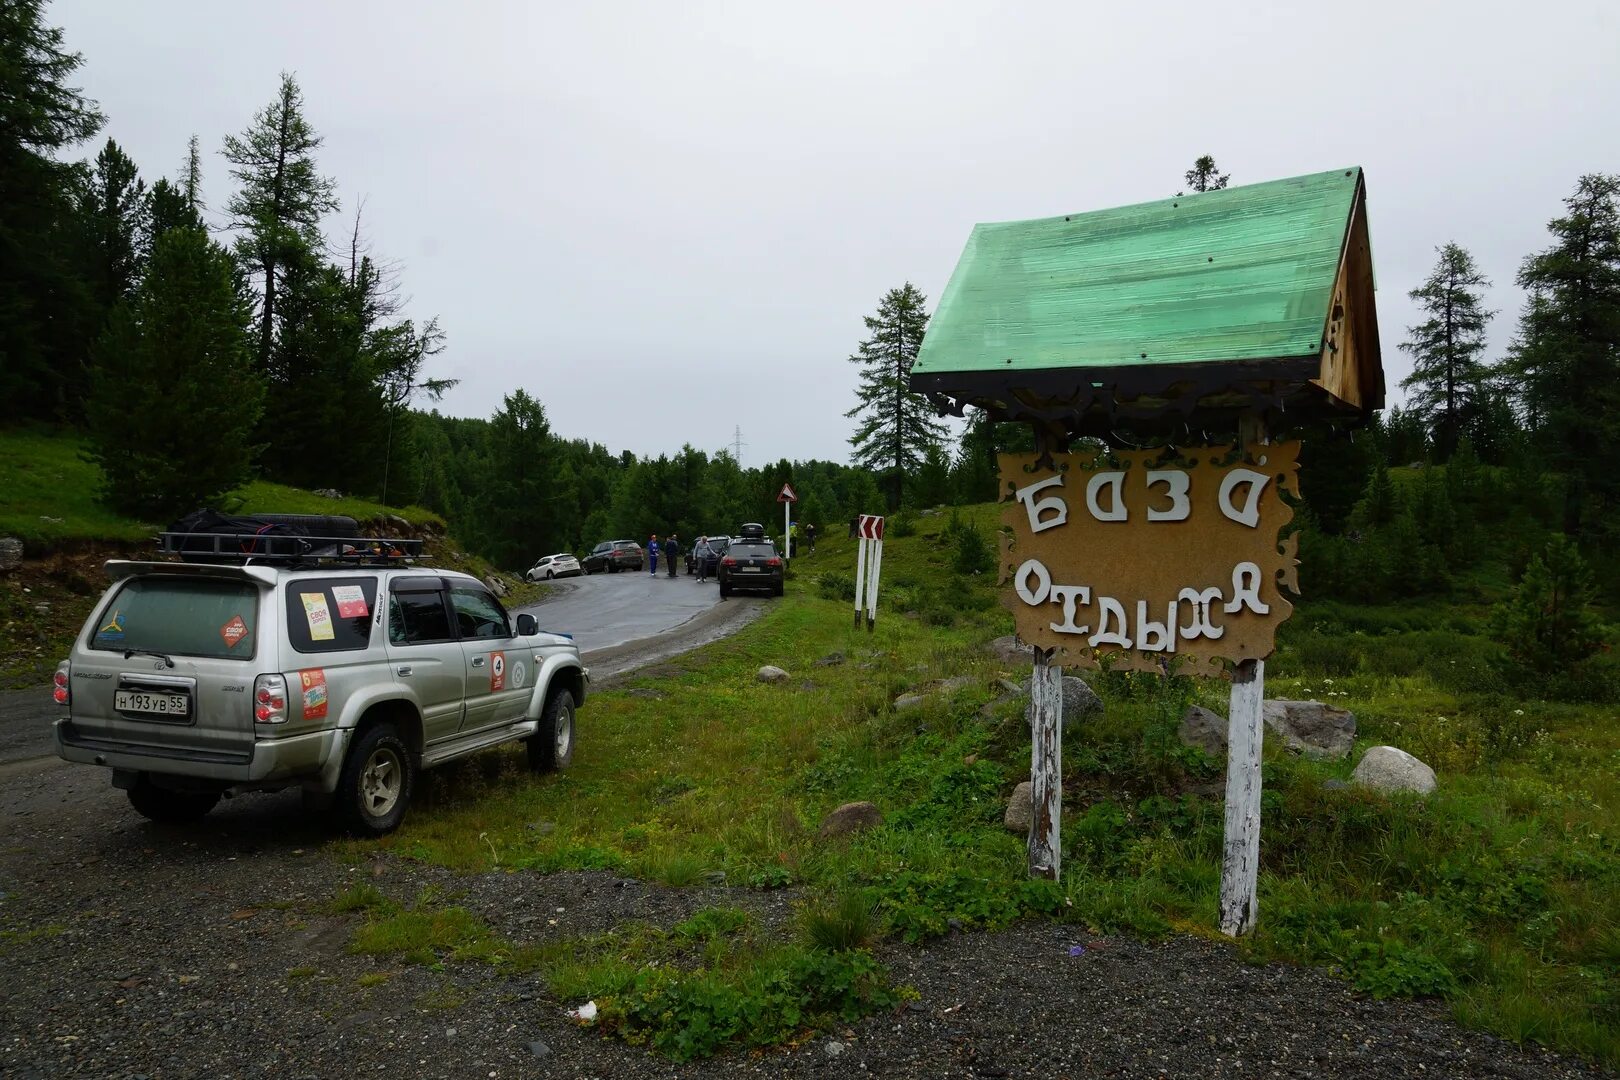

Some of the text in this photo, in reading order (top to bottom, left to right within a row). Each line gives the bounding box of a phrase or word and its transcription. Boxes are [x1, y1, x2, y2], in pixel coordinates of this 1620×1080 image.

[1015, 468, 1271, 533] БАЗА
[1014, 559, 1270, 653] ОТДЫХА
[302, 672, 311, 687] 6
[495, 660, 501, 671] 4
